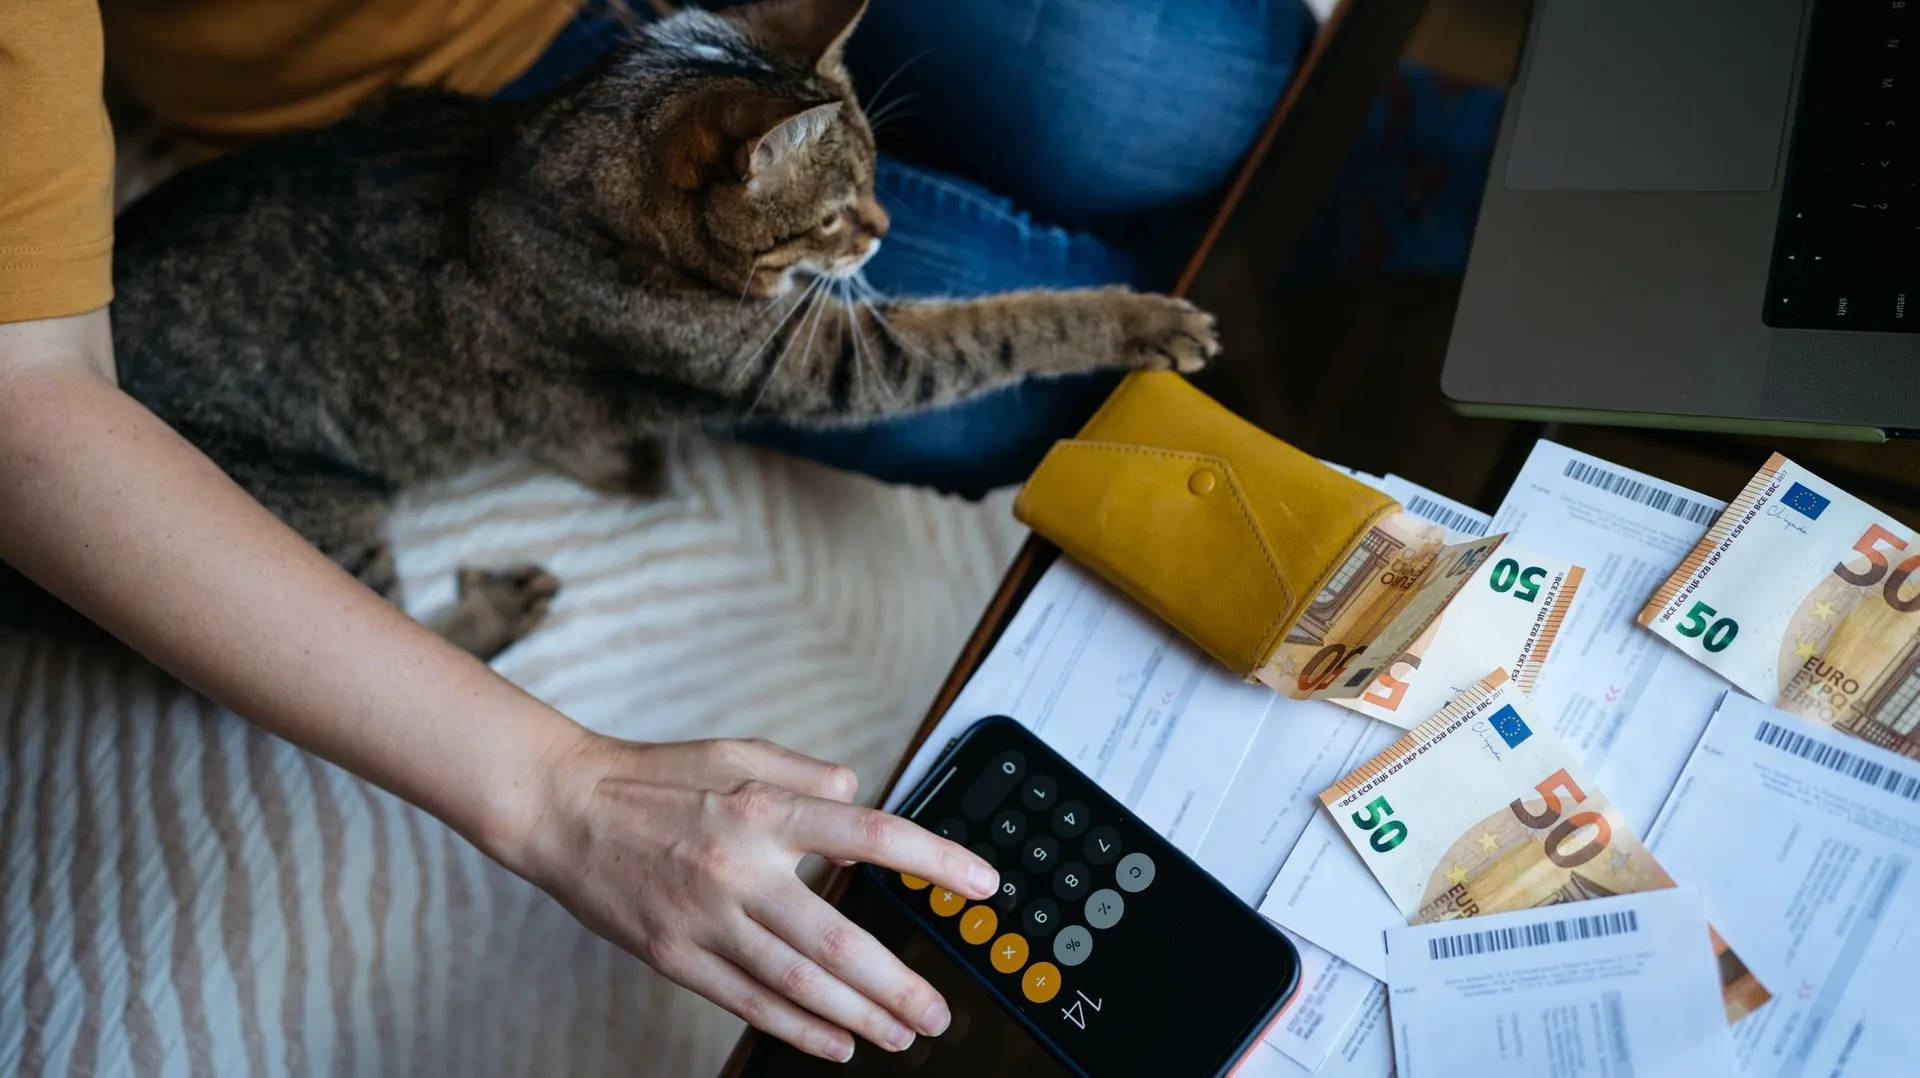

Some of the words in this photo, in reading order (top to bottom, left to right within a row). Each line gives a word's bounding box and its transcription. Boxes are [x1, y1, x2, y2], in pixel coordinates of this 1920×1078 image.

[1880, 78, 1895, 88] M
[1837, 297, 1848, 317] shift
[1895, 293, 1906, 319] return
[1675, 593, 1688, 608] ECB
[1698, 565, 1711, 580] EZB
[1709, 551, 1722, 567] EKP
[1720, 537, 1733, 553] EKT
[1731, 524, 1745, 540] ESB
[1743, 510, 1757, 526] EKB
[1765, 482, 1779, 498] EBC
[1776, 470, 1788, 483] 2017
[1833, 523, 1920, 612] 50
[1489, 557, 1548, 603] 50
[1544, 591, 1556, 606] ECB
[1529, 622, 1541, 637] EZB
[1675, 600, 1739, 653] 50
[1523, 637, 1534, 653] EKP
[1516, 653, 1527, 669] EKT
[1803, 656, 1859, 695] EURO
[1358, 783, 1373, 797] ECB
[1388, 762, 1403, 776] EZB
[1402, 752, 1418, 766] EKP
[1417, 742, 1432, 756] EKT
[1432, 732, 1447, 745] ESB
[1446, 720, 1462, 735] EKB
[1476, 698, 1493, 713] EBC
[1490, 688, 1505, 701] 2017
[1002, 761, 1016, 774] 0
[1033, 788, 1046, 799] 1
[1063, 812, 1075, 826] 4
[1350, 795, 1408, 853] 50
[1509, 767, 1612, 868] 50
[1001, 820, 1016, 834] 2
[1098, 838, 1111, 853] 7
[1033, 847, 1047, 861] 5
[1129, 866, 1142, 878] C
[1064, 874, 1079, 888] 8
[1002, 882, 1016, 896] 6
[1034, 910, 1048, 923] 9
[1065, 938, 1081, 952] %
[1061, 989, 1102, 1030] 14
